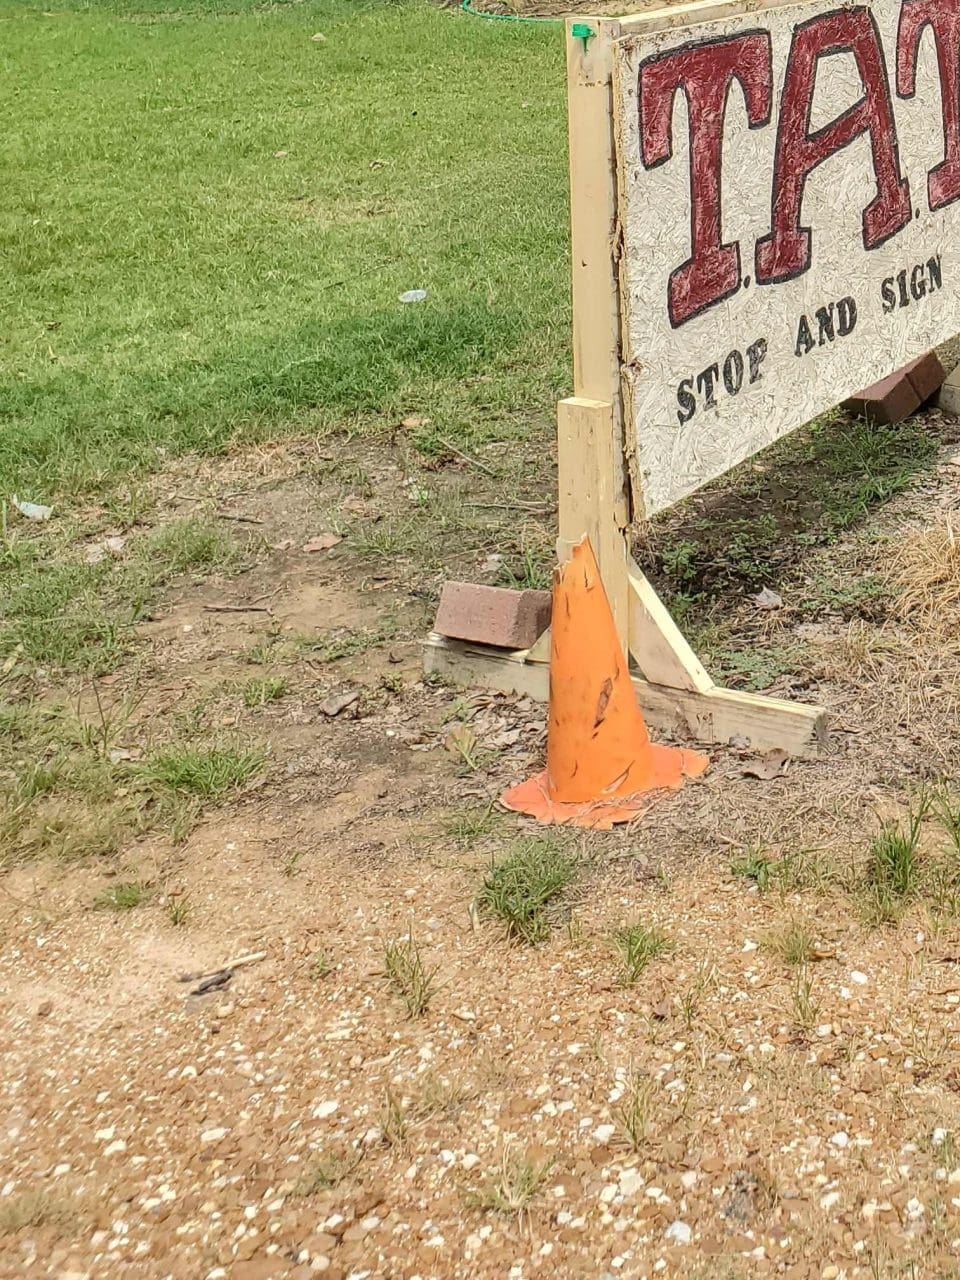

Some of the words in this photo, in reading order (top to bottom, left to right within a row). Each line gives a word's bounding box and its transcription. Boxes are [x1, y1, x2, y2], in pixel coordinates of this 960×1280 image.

[677, 337, 768, 426] STOP
[794, 296, 858, 357] AND
[881, 254, 943, 314] SIGN
